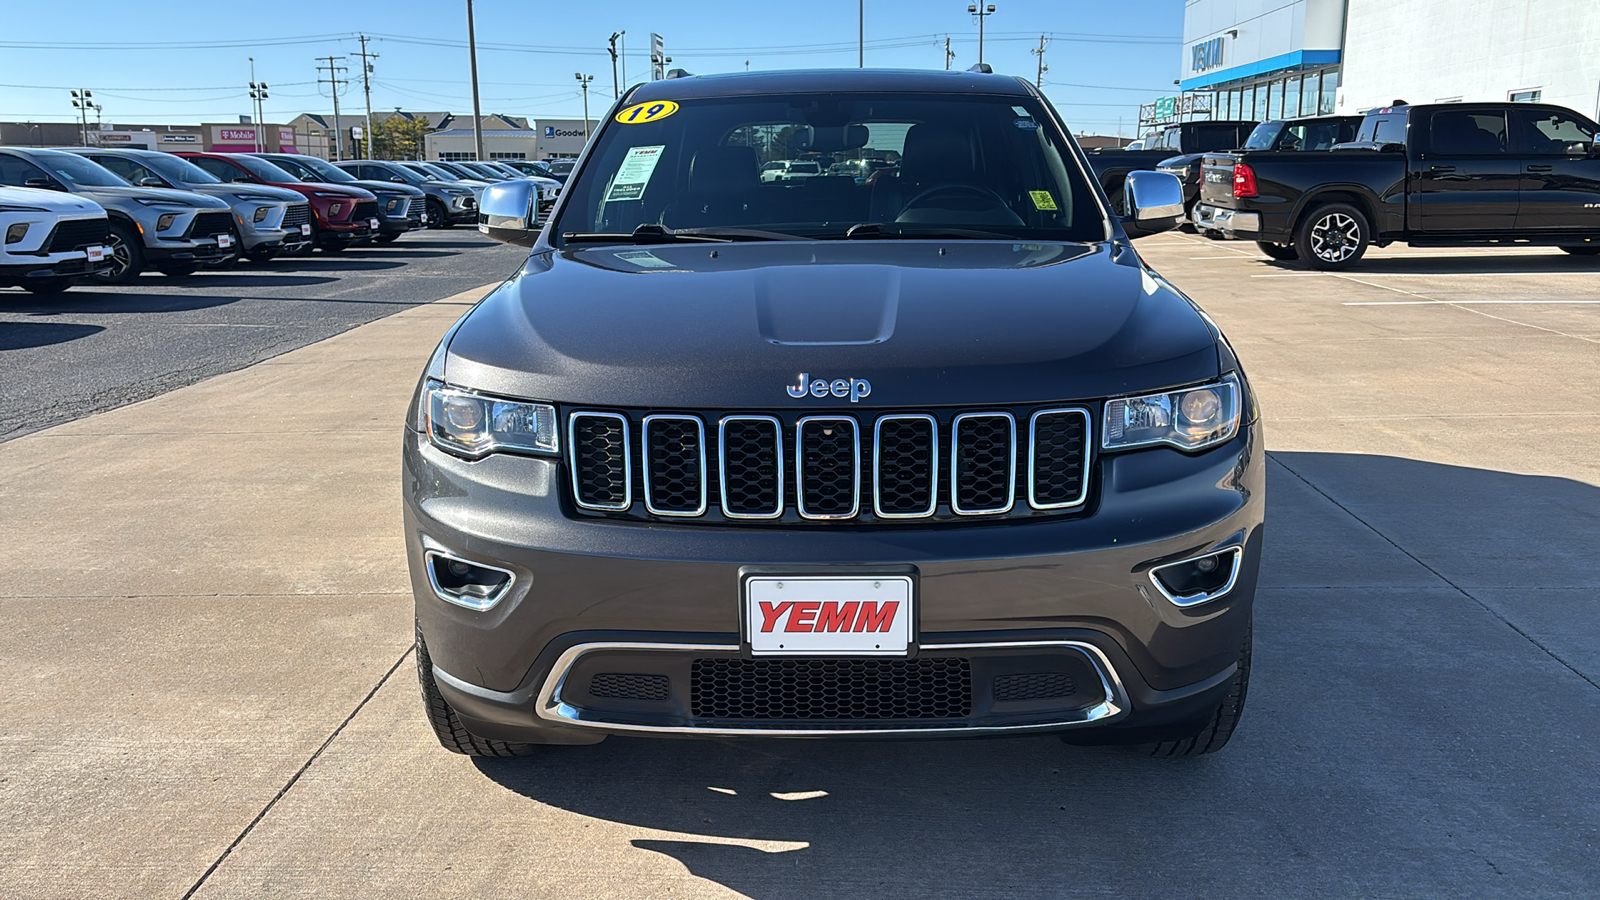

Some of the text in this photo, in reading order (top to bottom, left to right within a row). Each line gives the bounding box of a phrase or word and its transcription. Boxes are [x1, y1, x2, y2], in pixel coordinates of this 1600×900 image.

[628, 104, 665, 121] 19
[786, 372, 872, 403] Jeep
[758, 601, 900, 633] YEMM
